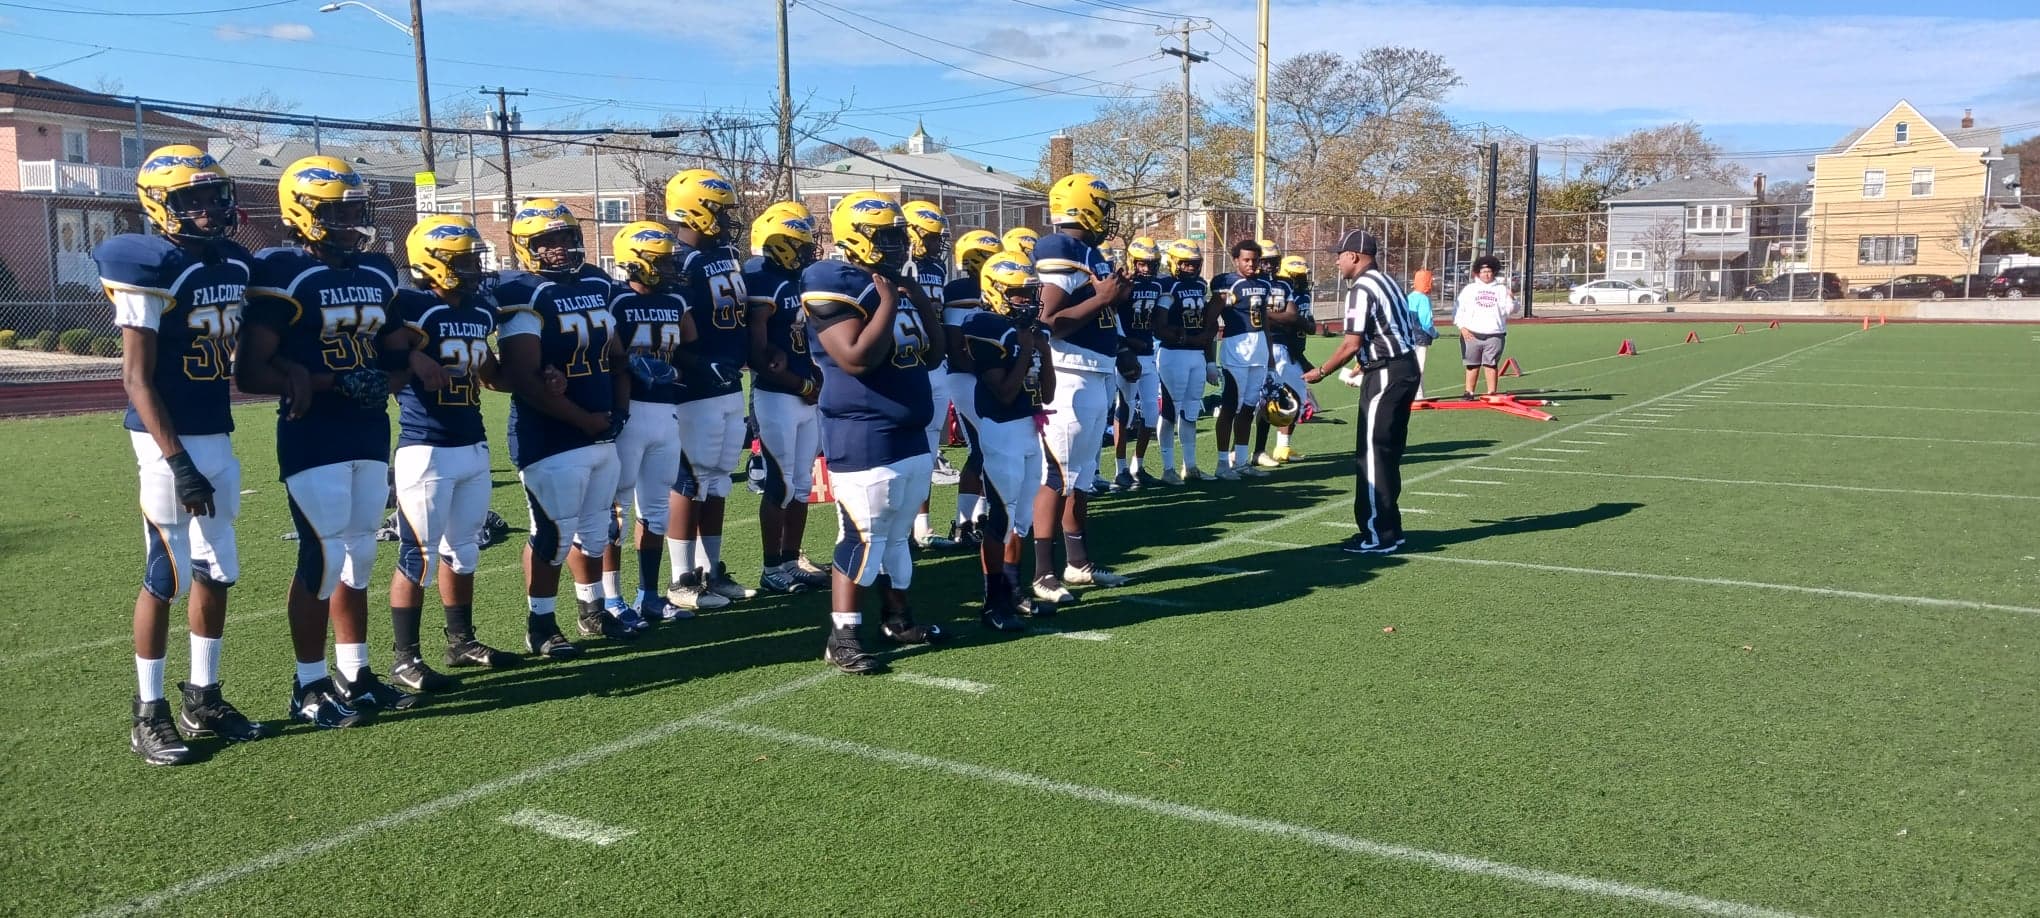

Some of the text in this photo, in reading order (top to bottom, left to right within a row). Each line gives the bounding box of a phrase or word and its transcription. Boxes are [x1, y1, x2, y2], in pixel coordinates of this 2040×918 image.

[420, 201, 433, 211] 20
[192, 284, 247, 306] FALCONS
[319, 286, 382, 305] FALCONS
[1242, 287, 1267, 297] FALCONS
[554, 294, 606, 312] FALCONS
[625, 308, 679, 322] FALCONS
[557, 308, 616, 377] 77
[811, 458, 828, 503] 4
